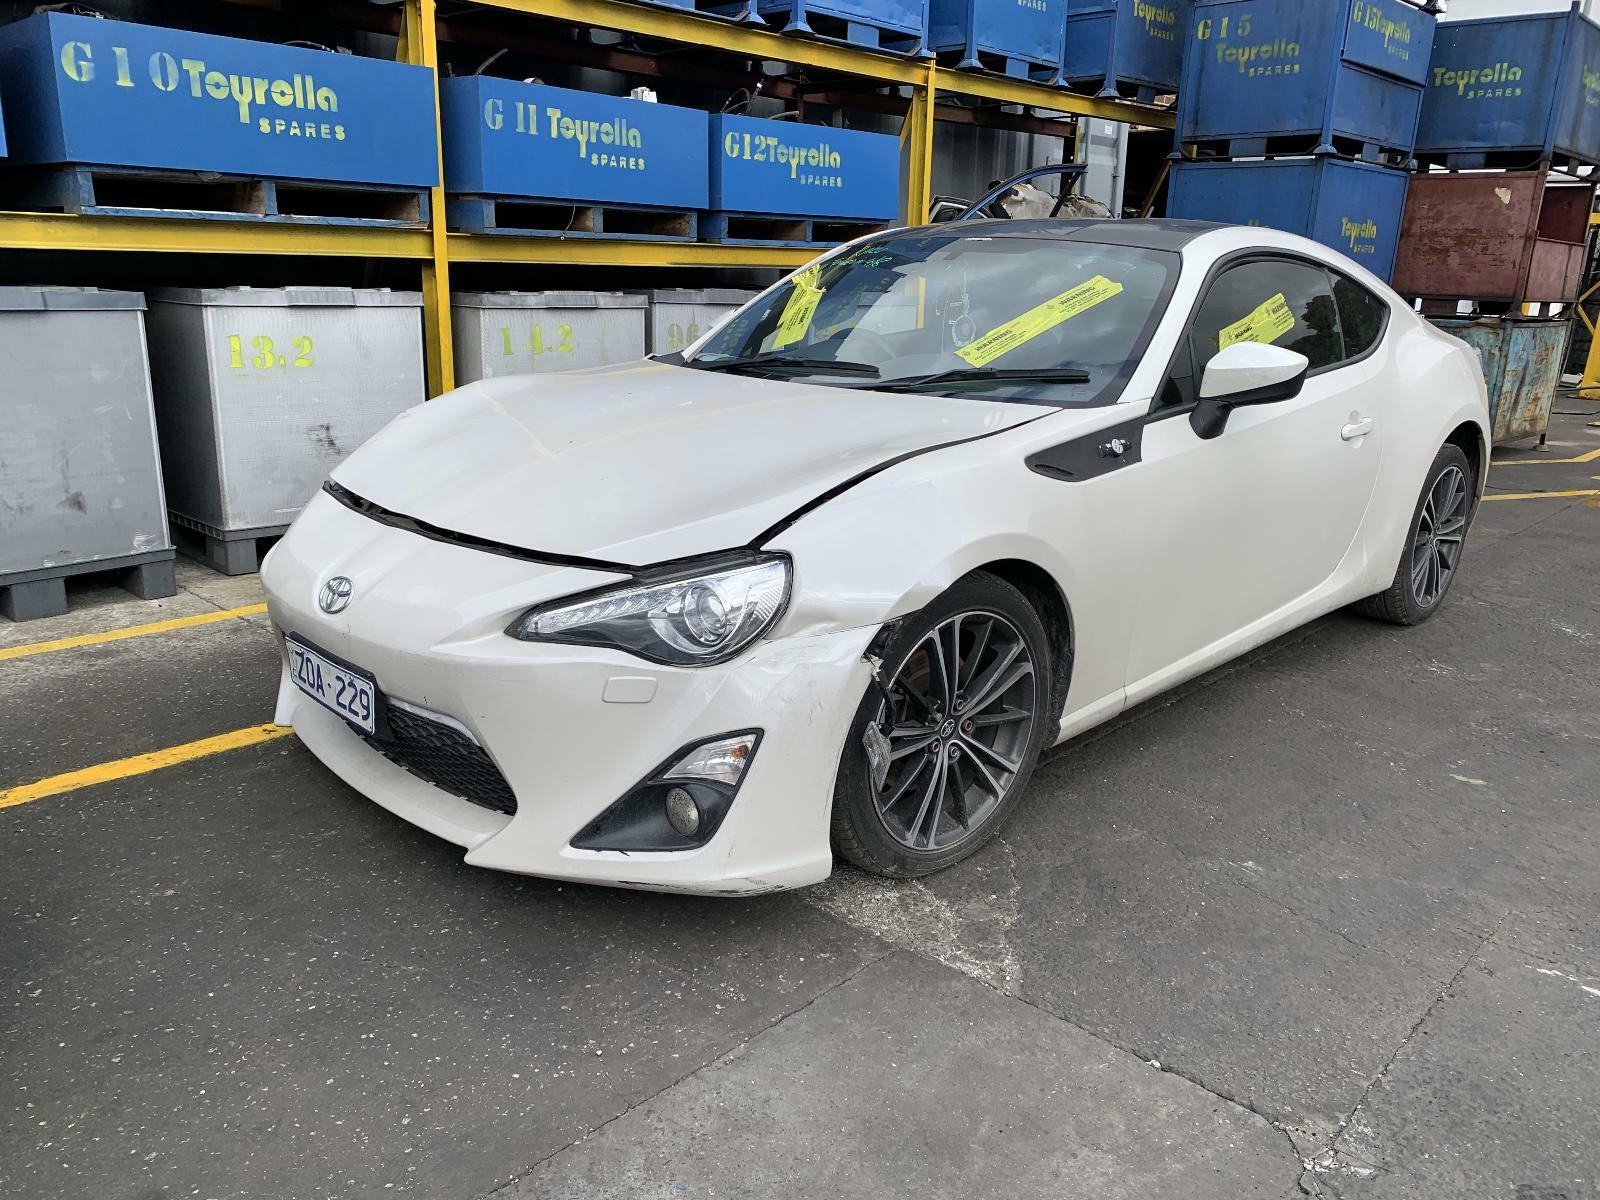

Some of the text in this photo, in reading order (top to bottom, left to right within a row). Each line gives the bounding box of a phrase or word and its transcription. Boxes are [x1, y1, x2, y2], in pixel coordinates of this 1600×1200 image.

[1216, 39, 1300, 72] Toyrolla
[1249, 64, 1300, 77] SPARES
[1433, 62, 1522, 95] Toyrolla
[181, 58, 339, 124] Toyrolla
[1466, 87, 1522, 99] SPARES
[259, 118, 346, 141] SPARES
[546, 107, 642, 158] Toyrolla
[591, 153, 646, 170] SPARES
[766, 137, 841, 179] Toyrolla
[800, 174, 843, 188] SPARES
[1058, 286, 1096, 306] WARNING
[228, 333, 315, 369] 13.2
[501, 323, 575, 356] 14.2
[974, 328, 1014, 352] WARNING
